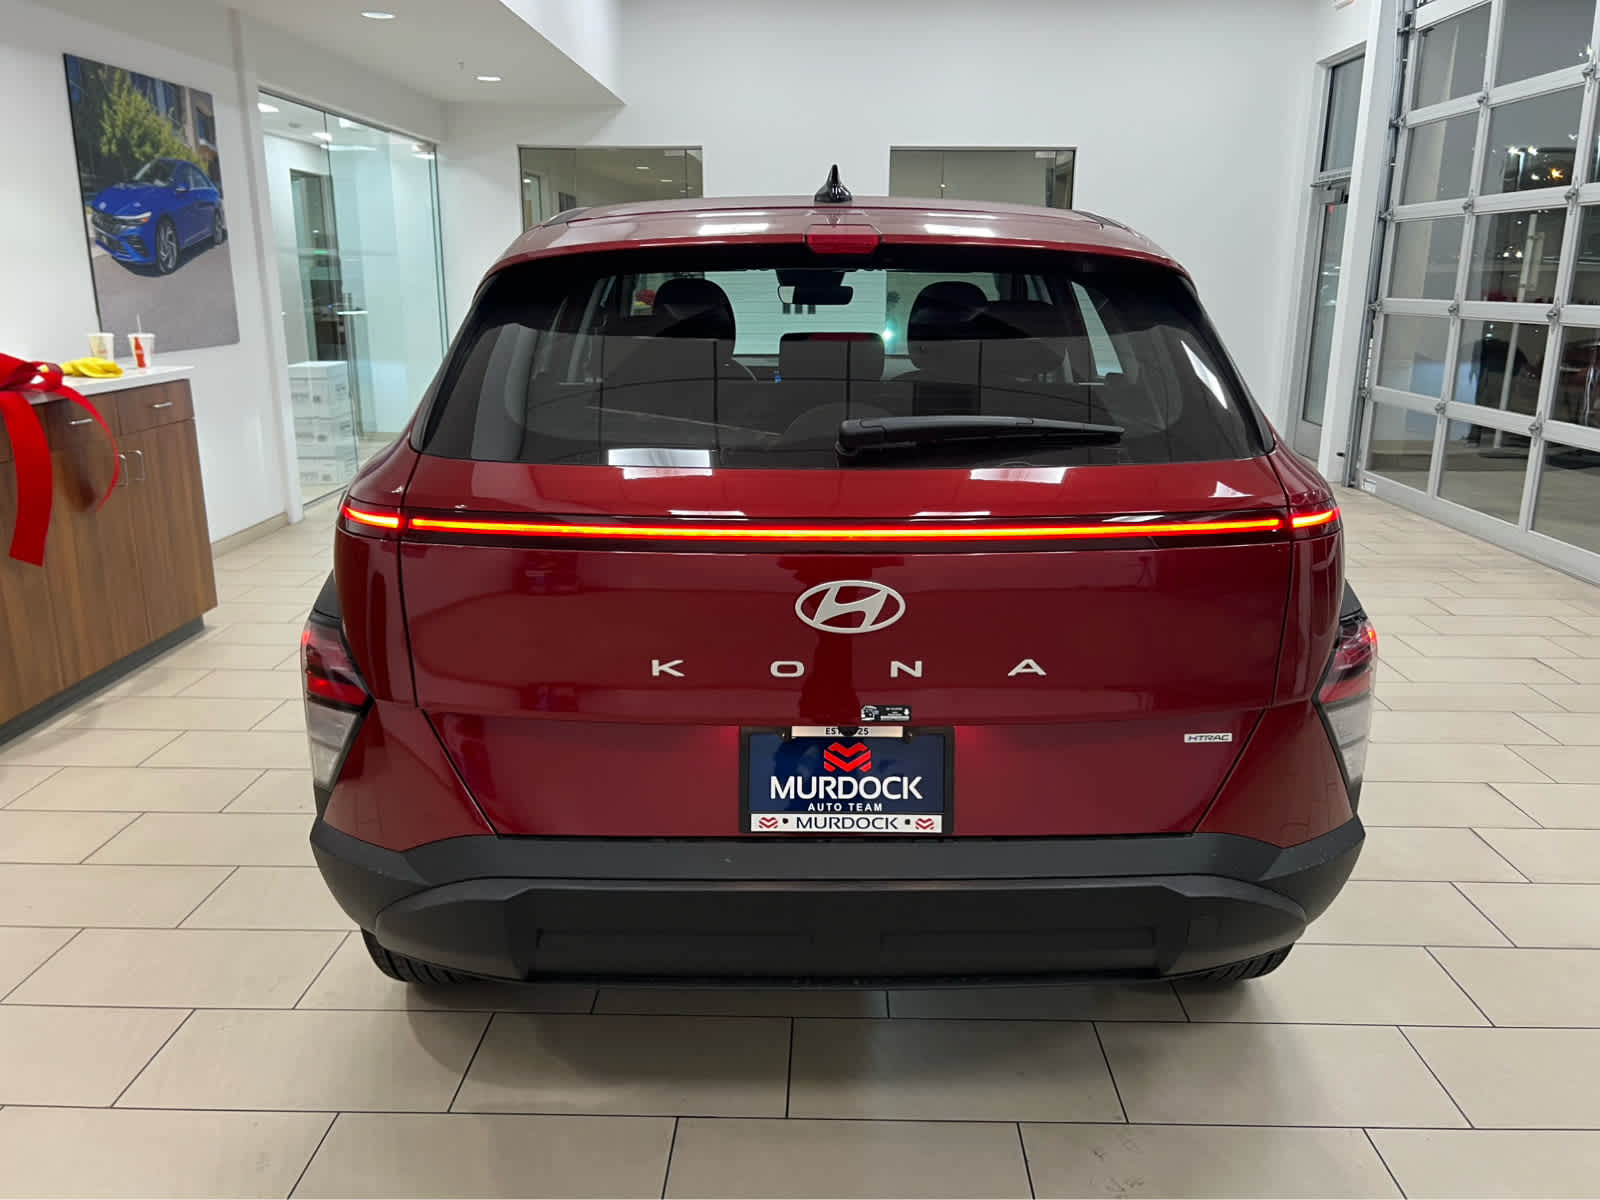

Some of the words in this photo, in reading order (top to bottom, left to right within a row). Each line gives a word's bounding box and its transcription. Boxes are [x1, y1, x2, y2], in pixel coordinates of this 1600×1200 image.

[651, 659, 1047, 678] KONA
[1187, 734, 1230, 742] HTRAC
[770, 775, 923, 800] MURDOCK
[807, 802, 843, 812] AUTO
[848, 802, 883, 812] TEAM
[796, 816, 899, 830] MURDOCK
